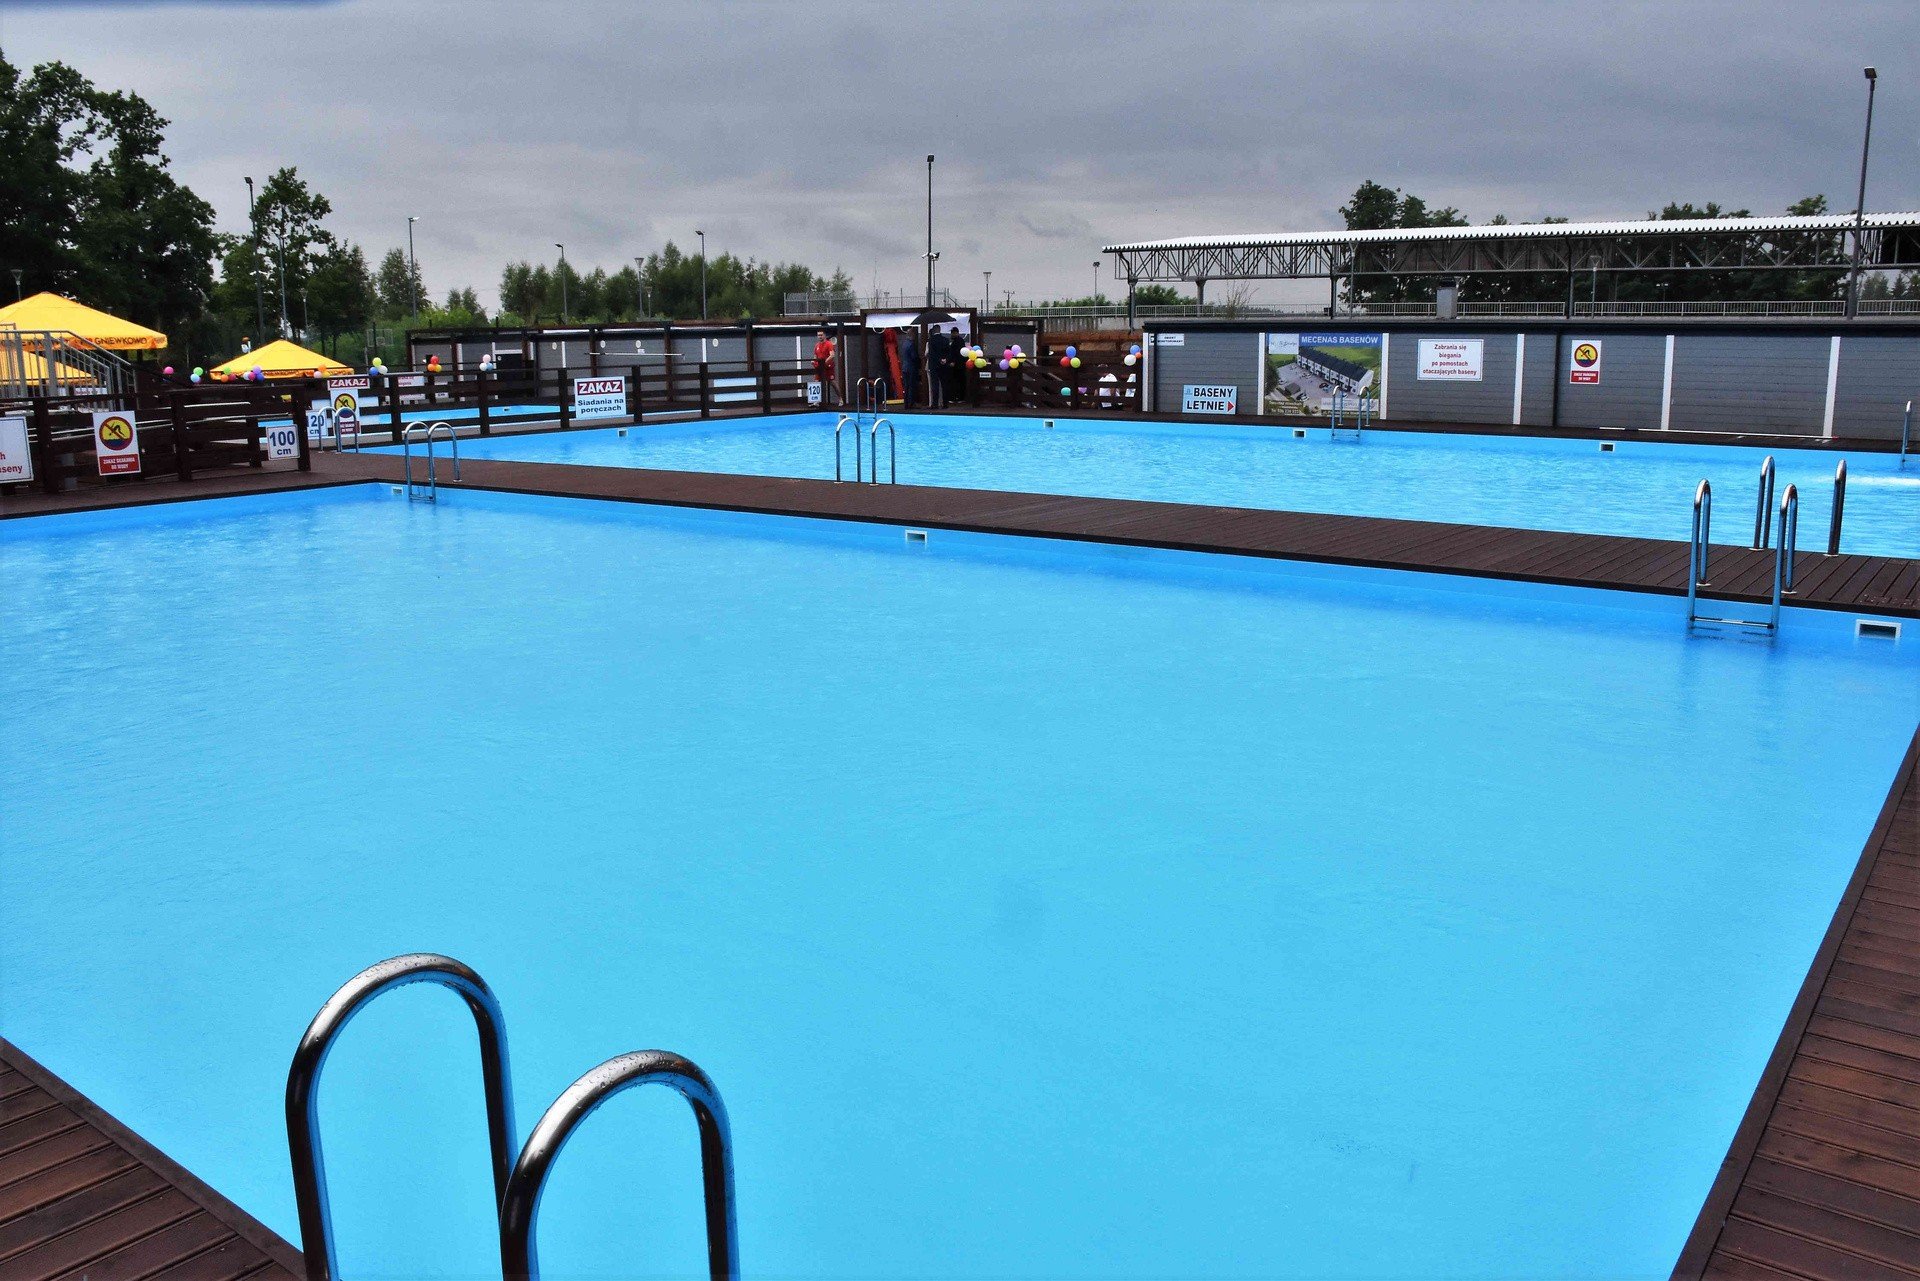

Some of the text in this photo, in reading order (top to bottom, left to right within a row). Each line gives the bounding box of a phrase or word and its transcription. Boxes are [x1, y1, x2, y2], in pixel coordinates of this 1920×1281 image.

[95, 336, 148, 345] GNIEWKOWO
[1301, 336, 1338, 344] MECENAS
[1339, 335, 1379, 344] BASENÓW
[330, 378, 367, 387] ZAKAZ
[578, 381, 621, 394] ZAKAZ
[808, 385, 820, 395] 120
[1193, 387, 1233, 398] BASENY
[577, 398, 612, 406] Siadania
[1186, 400, 1225, 410] LETNIE
[581, 405, 622, 414] poręczach
[269, 430, 296, 447] 100
[276, 448, 292, 456] cm
